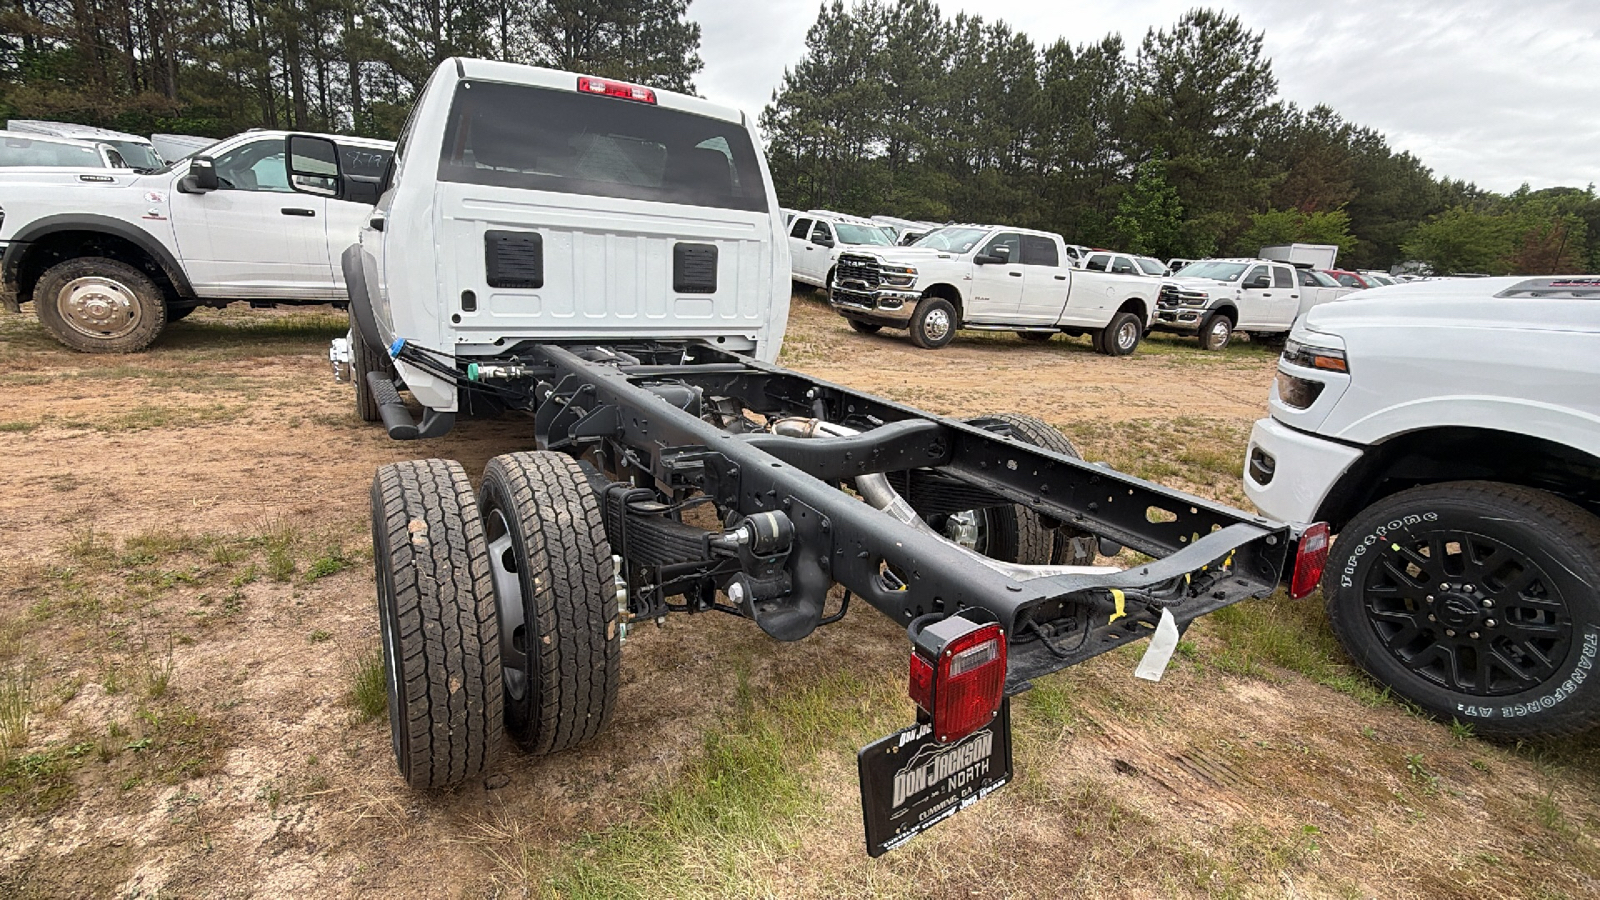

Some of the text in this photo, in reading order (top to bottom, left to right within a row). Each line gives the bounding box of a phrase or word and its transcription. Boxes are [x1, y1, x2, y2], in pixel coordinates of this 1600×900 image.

[1341, 512, 1438, 588] Firestone
[1501, 633, 1597, 718] TRANSFORCE
[892, 732, 993, 808] DON JACKSON
[947, 758, 990, 793] NORTH
